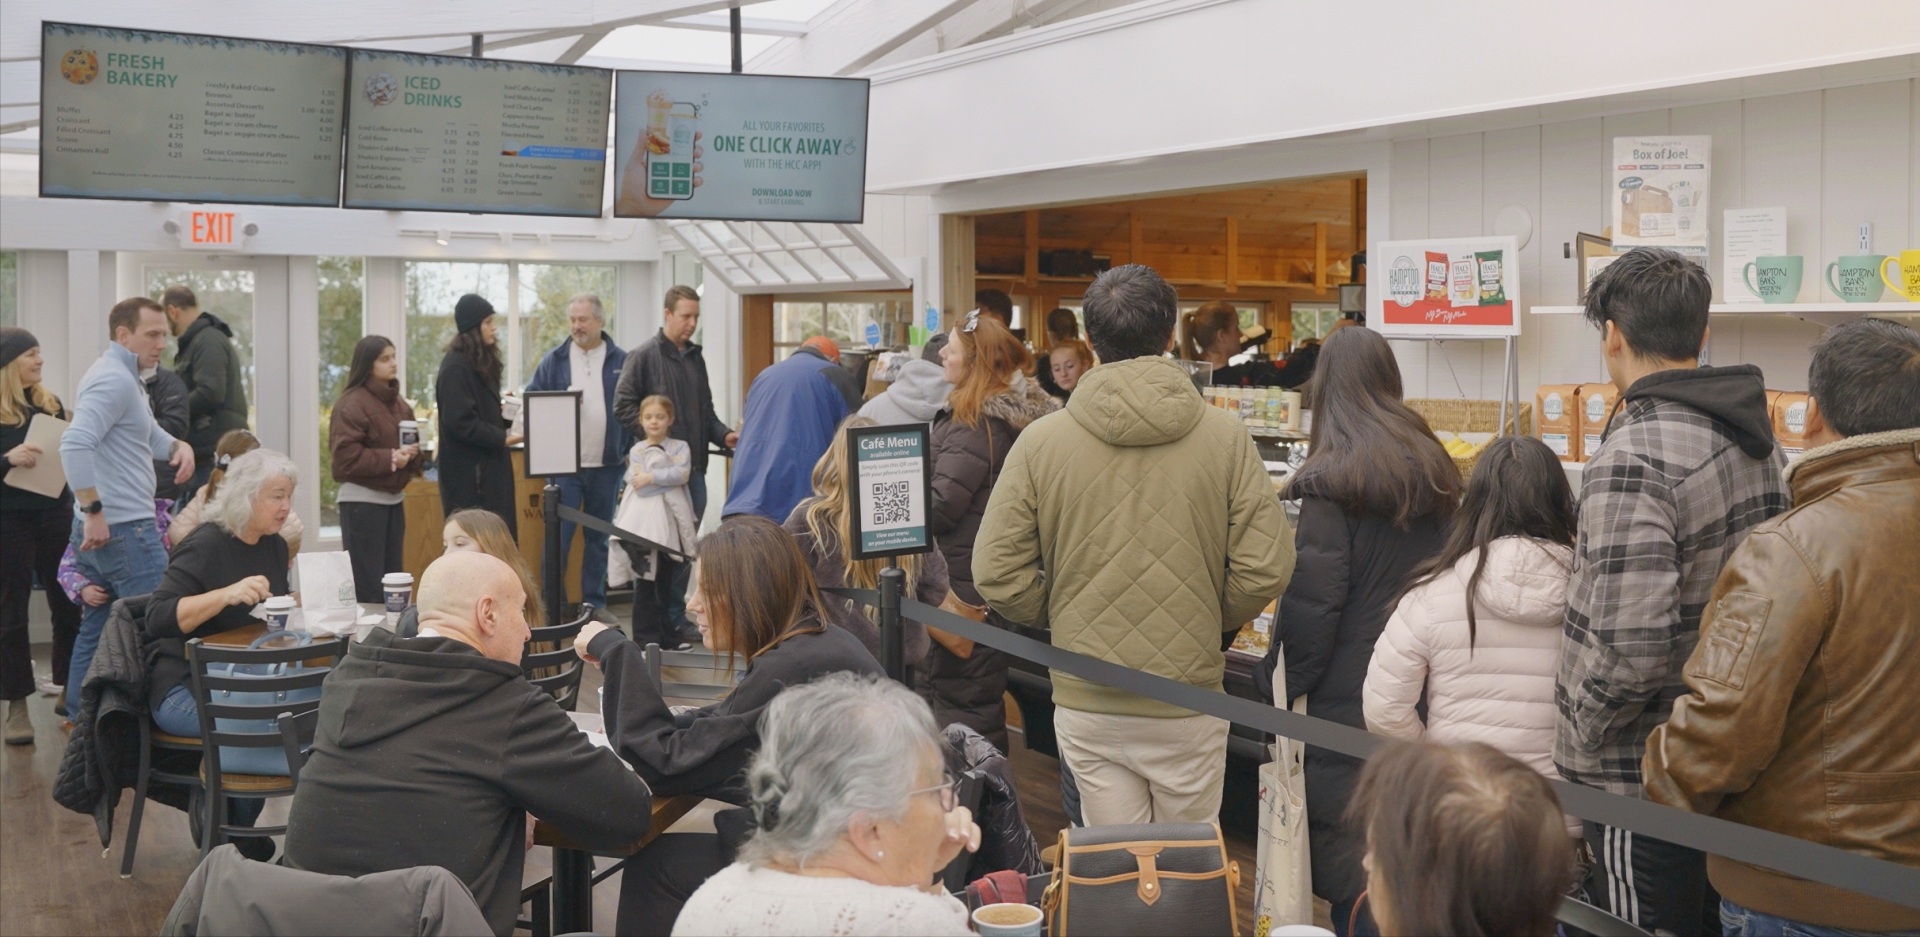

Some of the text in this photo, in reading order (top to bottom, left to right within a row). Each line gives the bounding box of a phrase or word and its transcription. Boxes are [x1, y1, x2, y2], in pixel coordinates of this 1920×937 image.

[107, 52, 165, 70] FRESH
[106, 70, 178, 88] BAKERY
[404, 75, 441, 90] ICED
[205, 100, 264, 110] Assorted Desserts
[404, 92, 462, 108] DRINKS
[56, 116, 90, 124] Croissant
[204, 110, 224, 118] Bagel
[204, 119, 224, 128] Bagel
[743, 120, 825, 132] ALL YOUR FAVORITES
[56, 126, 111, 136] Filled Croissant
[204, 129, 223, 137] Bagel
[234, 131, 256, 140] veggie
[56, 146, 94, 154] Cinnamon
[714, 135, 842, 155] ONE CLICK AWAY
[226, 149, 265, 158] Continental
[1633, 148, 1688, 160] Box of Joe!
[744, 158, 822, 170] WITH THE HCC APP!
[752, 188, 812, 198] DOWNLOAD NOW
[192, 212, 234, 243] EXIT
[1390, 268, 1418, 285] HAMPTON
[860, 436, 918, 450] Café Menu
[870, 450, 892, 458] available
